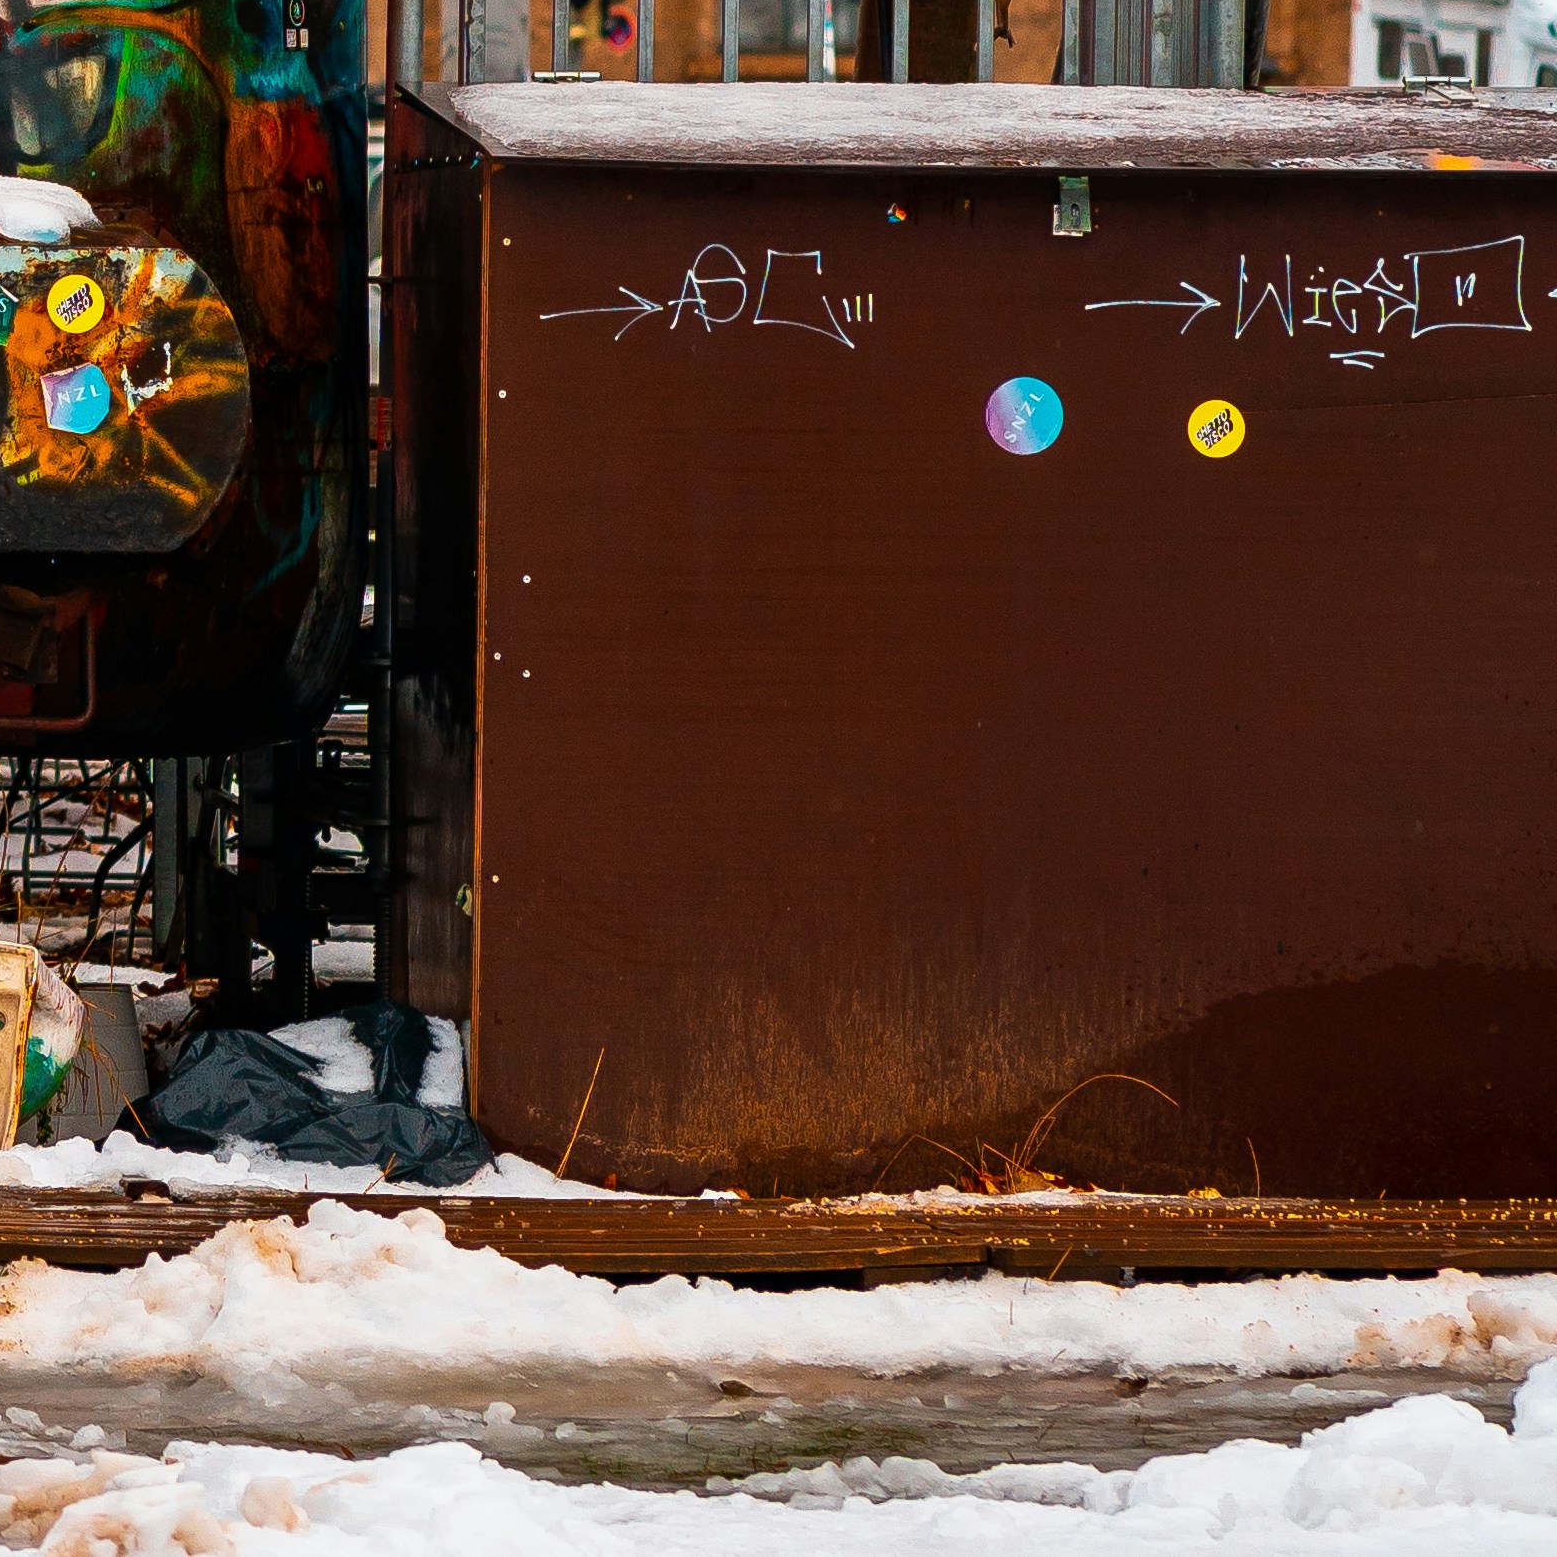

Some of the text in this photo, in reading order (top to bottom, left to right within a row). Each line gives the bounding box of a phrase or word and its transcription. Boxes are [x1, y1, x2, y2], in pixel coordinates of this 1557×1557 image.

[56, 285, 89, 317] GHETTO
[62, 296, 92, 325] DISCO
[1004, 393, 1044, 443] SNZL
[1196, 409, 1230, 441] GHETTO
[1203, 420, 1233, 450] DISCO
